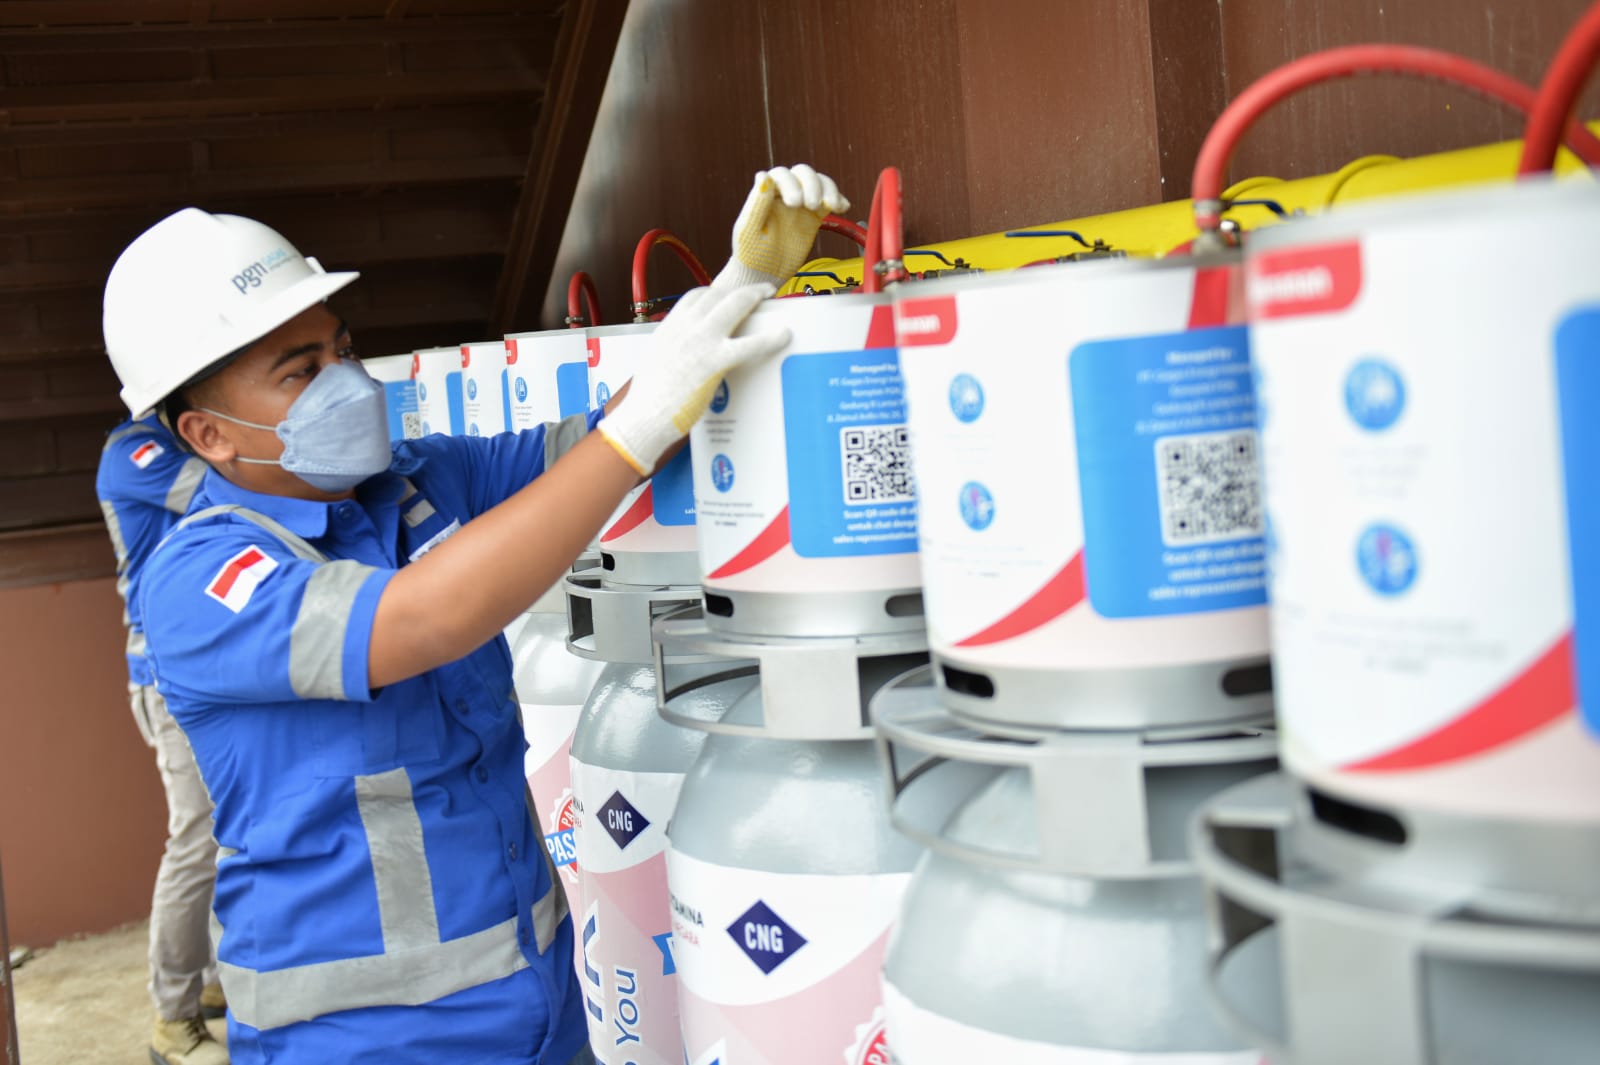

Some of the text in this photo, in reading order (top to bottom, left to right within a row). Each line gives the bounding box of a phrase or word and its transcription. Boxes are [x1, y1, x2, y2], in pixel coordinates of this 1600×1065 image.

[231, 262, 269, 294] pgn
[607, 808, 633, 833] CNG
[544, 831, 577, 863] PAS
[743, 921, 785, 954] CNG
[613, 968, 641, 1047] You
